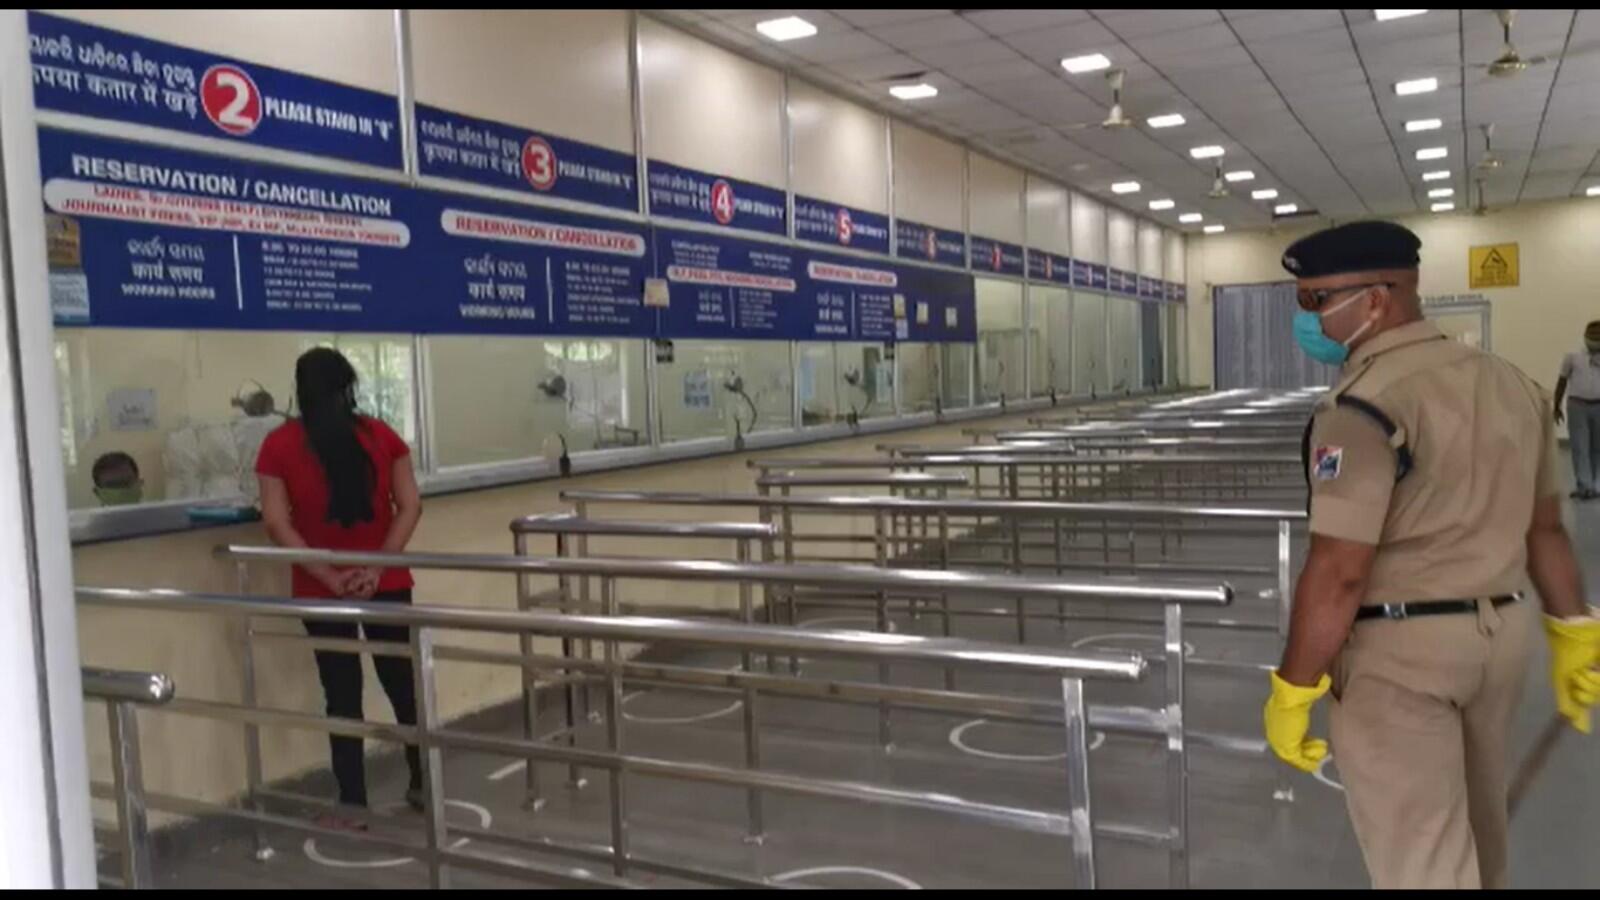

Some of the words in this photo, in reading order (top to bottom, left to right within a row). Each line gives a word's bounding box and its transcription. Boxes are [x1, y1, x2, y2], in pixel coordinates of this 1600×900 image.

[84, 73, 137, 103] कतार
[142, 78, 158, 106] में
[216, 71, 255, 130] 2
[265, 96, 313, 123] PLEASE
[316, 108, 357, 133] STAND
[359, 115, 372, 136] IN
[530, 143, 551, 182] 3
[72, 153, 237, 196] RESERVATION
[242, 178, 249, 198] /
[254, 180, 391, 216] CANCELLATION
[717, 186, 730, 218] 4
[455, 215, 546, 240] RESERVATION
[839, 214, 851, 243] 5
[131, 259, 164, 280] कार्य
[167, 265, 203, 283] समय
